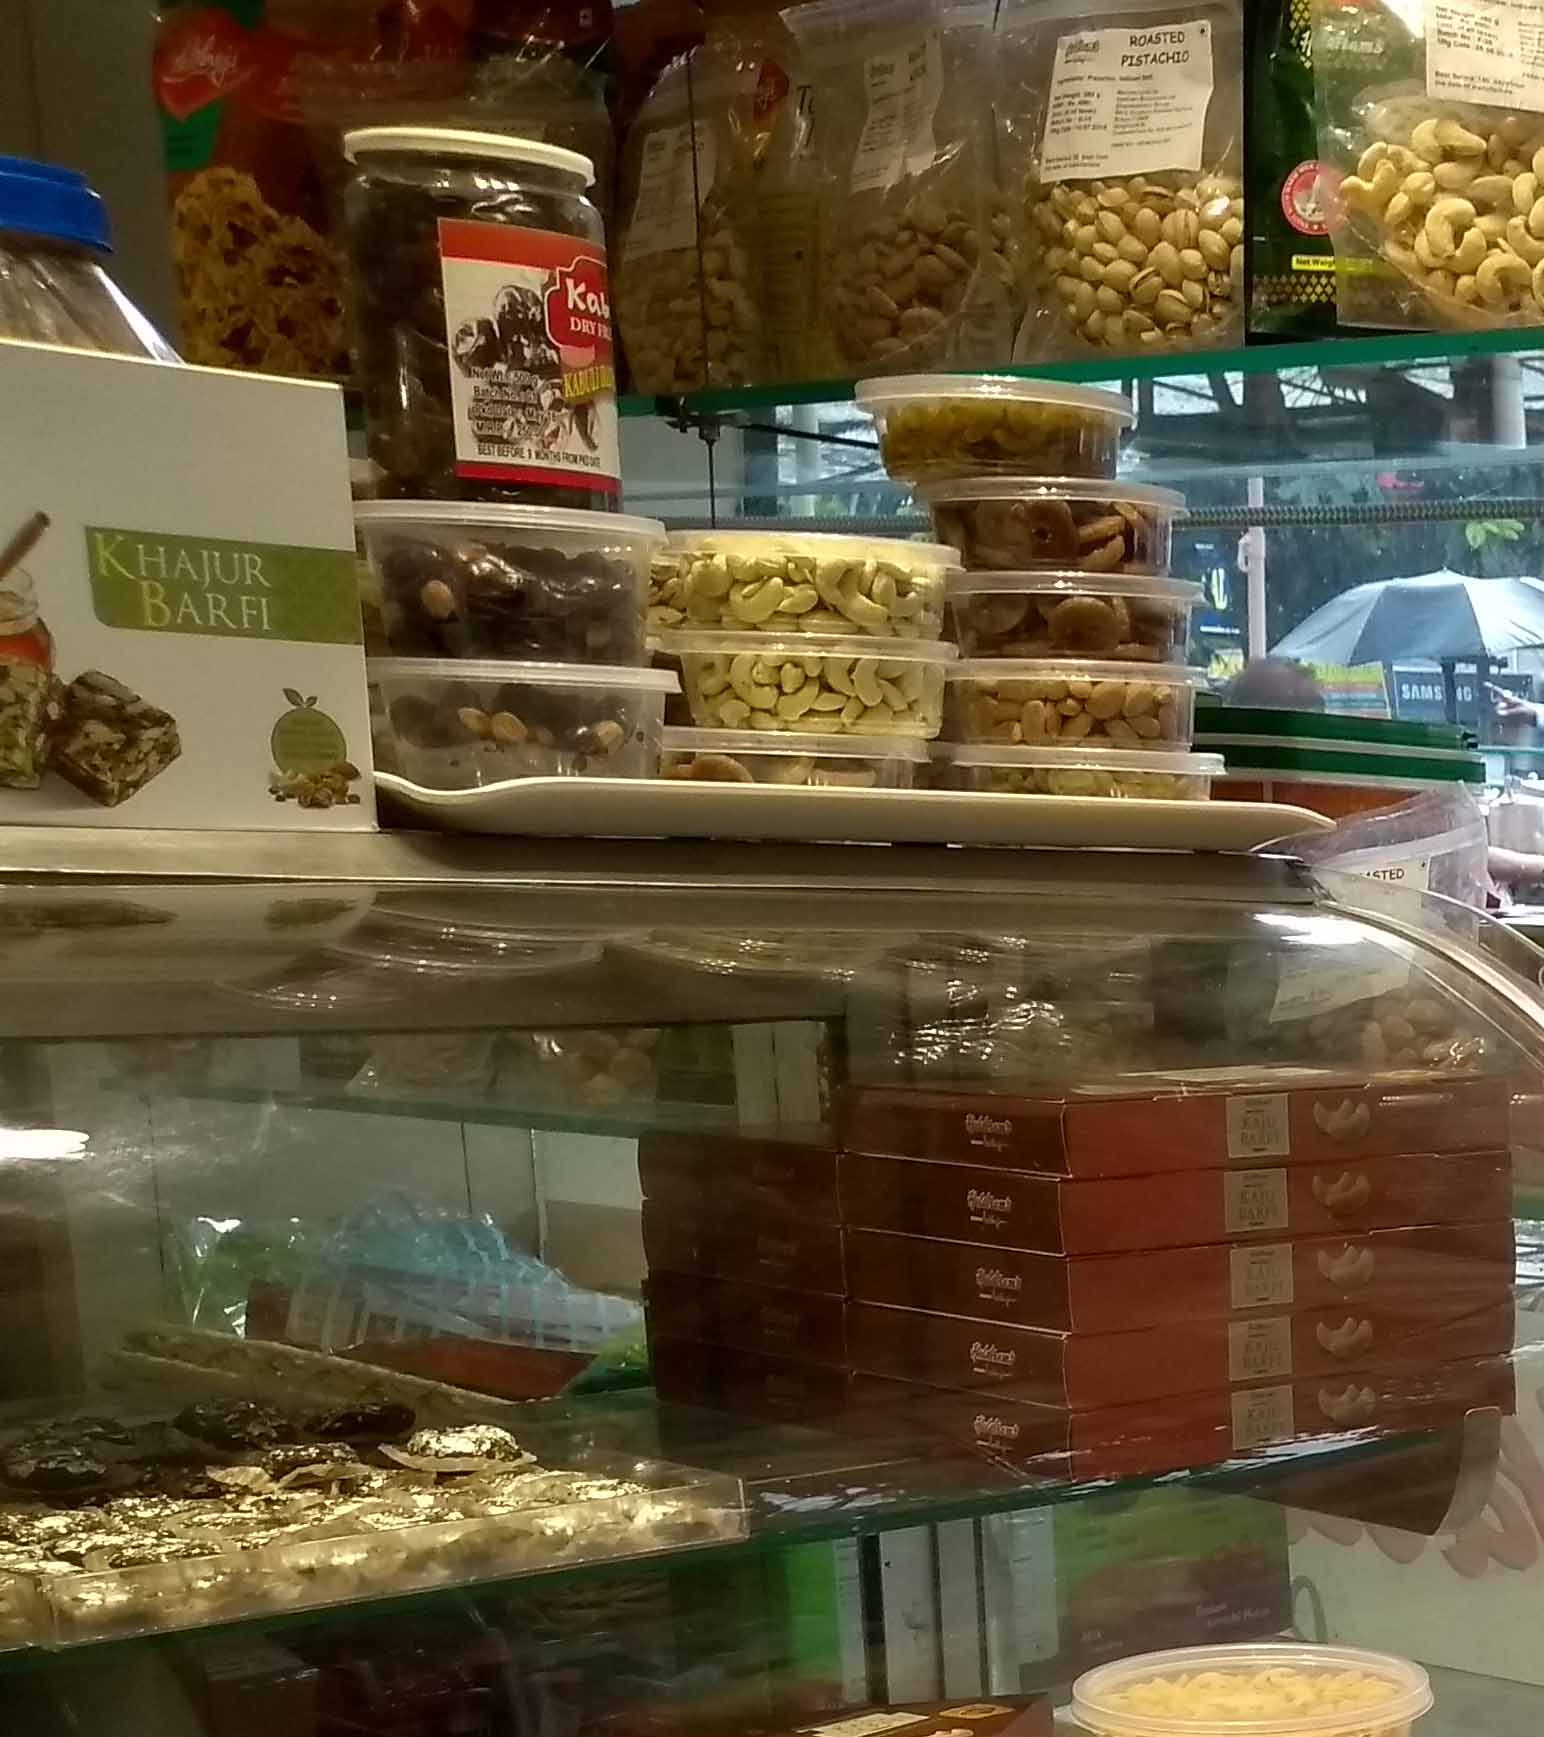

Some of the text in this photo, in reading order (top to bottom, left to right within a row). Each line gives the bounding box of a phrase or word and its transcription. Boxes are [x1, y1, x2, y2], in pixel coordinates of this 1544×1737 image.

[1129, 31, 1185, 48] ROASTED
[1121, 50, 1190, 67] PISTACHIO
[477, 443, 497, 456] BEST
[497, 445, 526, 461] BEFORE
[94, 533, 273, 590] KHAJUR
[142, 588, 273, 633] BARFI
